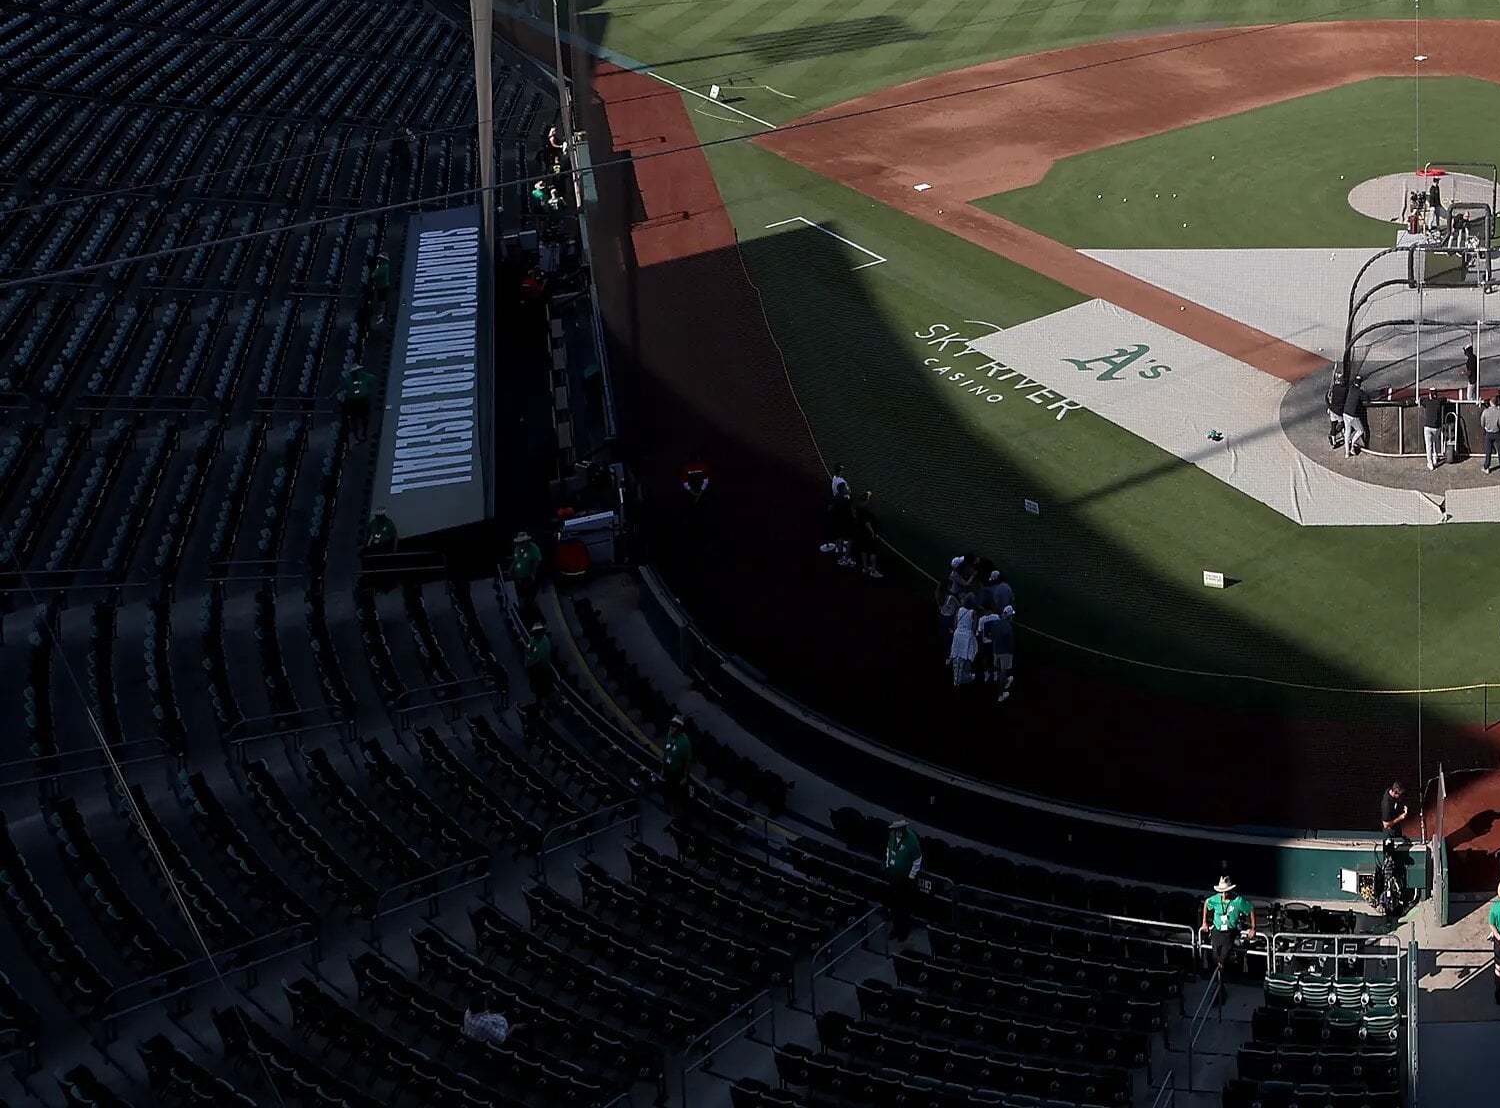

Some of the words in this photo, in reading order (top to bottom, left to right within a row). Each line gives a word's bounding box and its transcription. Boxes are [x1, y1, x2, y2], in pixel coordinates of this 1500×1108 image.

[410, 227, 479, 321] SACRAMENTO'S
[405, 320, 476, 364] HOME
[1060, 344, 1172, 381] A's
[401, 363, 475, 397] FOR
[914, 323, 978, 358] SKY
[976, 359, 1084, 421] RIVER
[924, 357, 1003, 403] CASINO
[390, 397, 474, 494] BASEBALL
